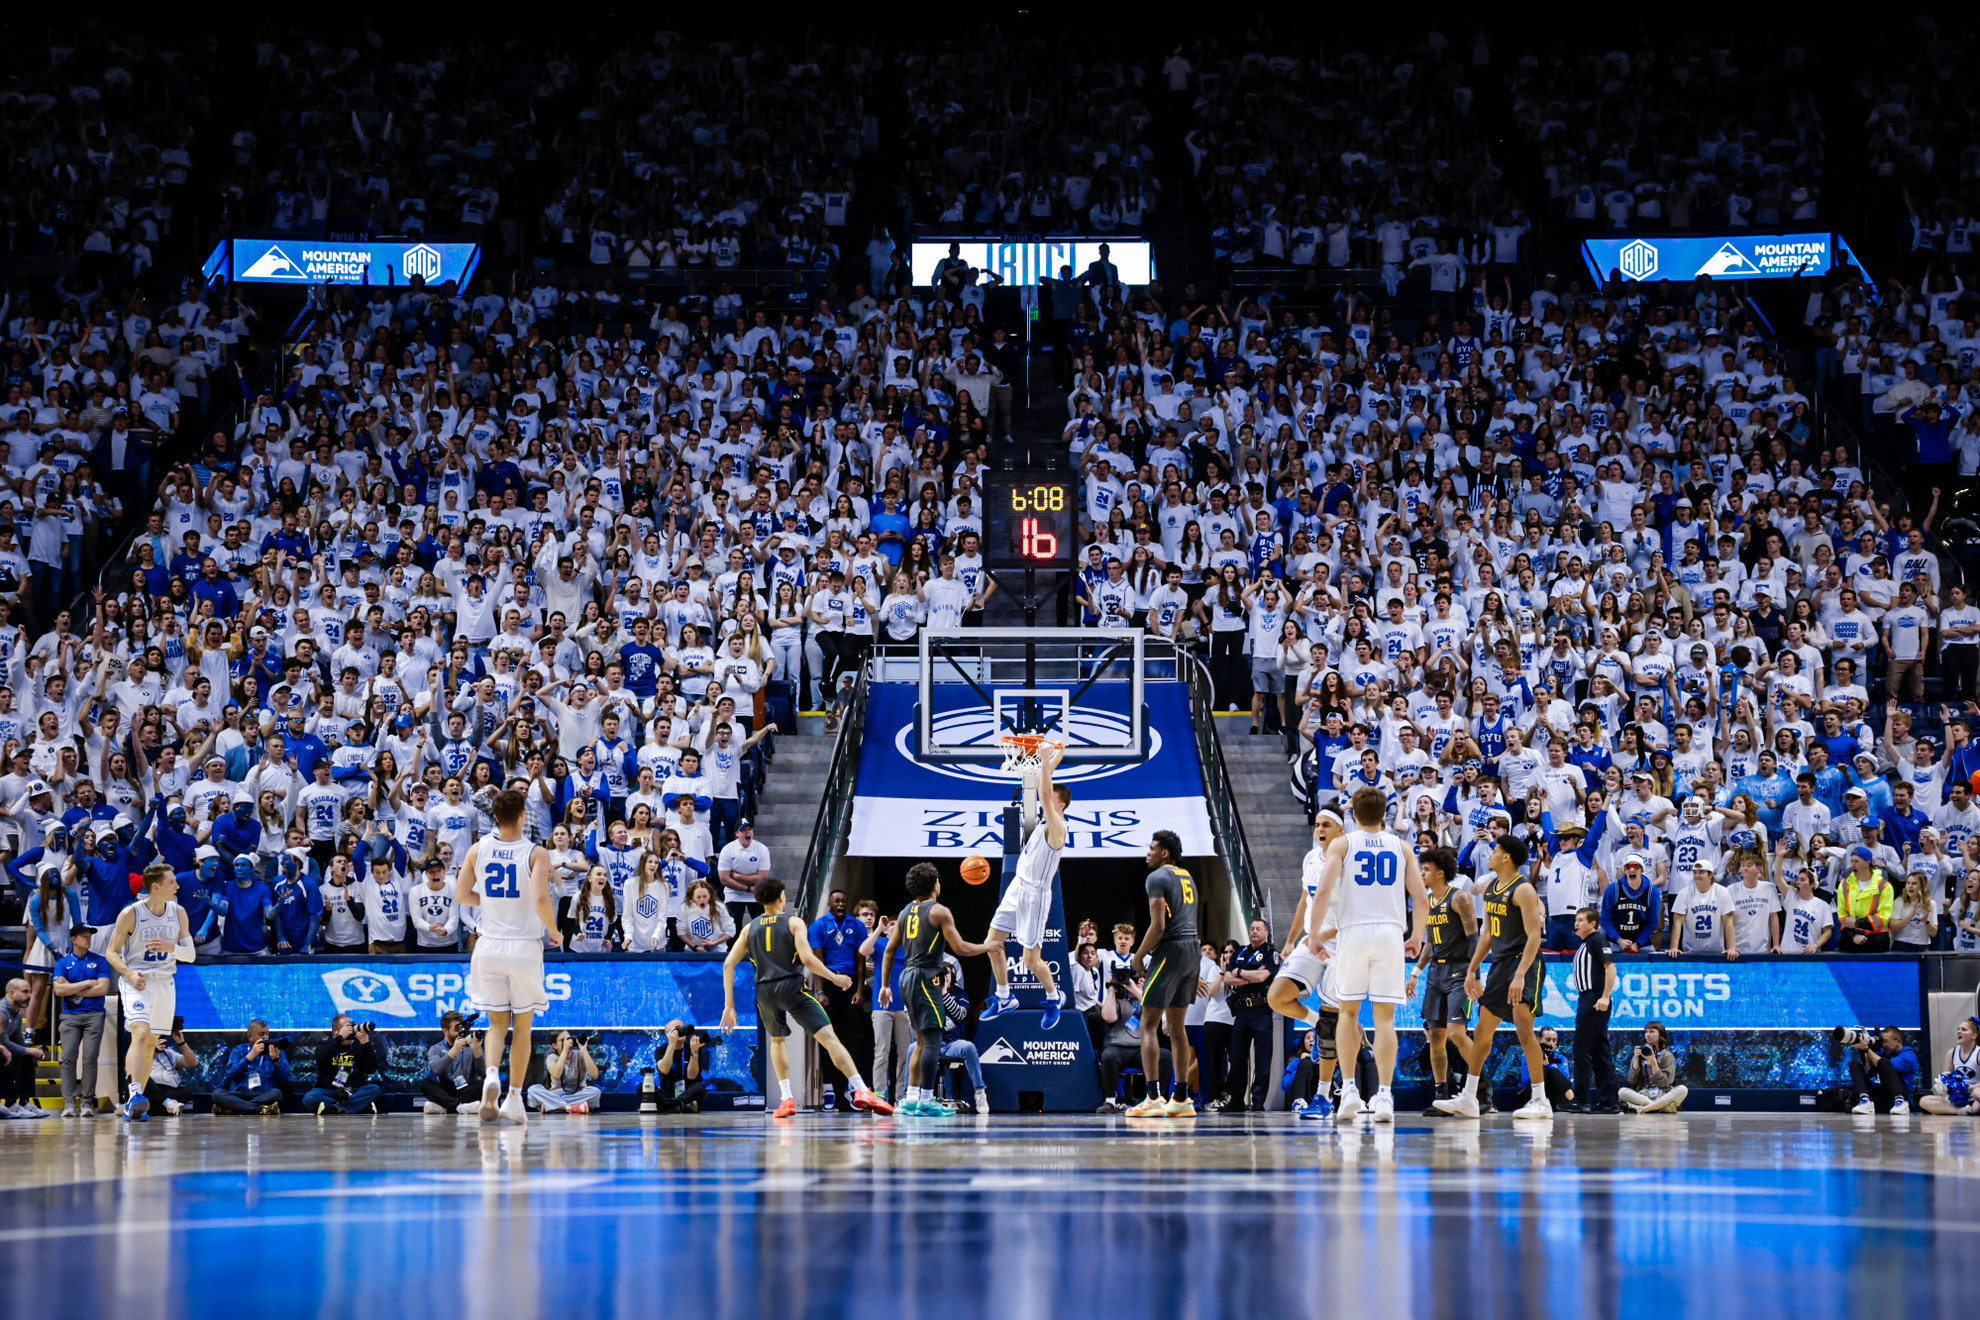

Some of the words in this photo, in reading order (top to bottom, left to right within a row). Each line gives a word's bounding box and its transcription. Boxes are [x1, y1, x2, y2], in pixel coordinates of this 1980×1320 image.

[1755, 242, 1825, 256] MOUNTAIN
[302, 250, 372, 262] MOUNTAIN
[1759, 254, 1820, 268] AMERICA
[306, 262, 365, 274] AMERICA
[1592, 414, 1605, 424] 24
[606, 484, 620, 495] 24
[1836, 480, 1848, 488] 32
[1012, 486, 1064, 511] 6:08
[1096, 492, 1110, 504] 24
[180, 514, 190, 522] 23
[1022, 518, 1056, 559] 16
[1261, 547, 1274, 558] 23
[1904, 559, 1928, 569] BALL
[964, 574, 977, 588] 24
[326, 624, 340, 638] 24
[1385, 630, 1408, 638] BRIGHAM
[1432, 627, 1456, 636] BRIGHAM
[1388, 640, 1402, 652] 24
[380, 686, 398, 694] CHOOSE
[384, 694, 396, 704] 32
[1501, 704, 1516, 719] 24
[1480, 734, 1502, 742] BYU
[1488, 744, 1493, 756] 1
[347, 754, 366, 762] CHOOSE
[450, 754, 468, 770] 32
[651, 756, 676, 766] BRIGHAM
[655, 764, 671, 778] 24
[608, 775, 622, 786] 32
[310, 797, 340, 806] BRIGHAM
[316, 805, 334, 820] 24
[924, 808, 1141, 828] ZINS
[408, 826, 425, 841] 24
[1946, 826, 1973, 834] BRIGHAM
[1366, 838, 1384, 848] HALL
[492, 850, 514, 860] KNELL
[1679, 846, 1698, 862] 23
[1354, 851, 1398, 886] 30
[485, 863, 520, 898] 21
[1555, 868, 1560, 882] 1
[1180, 878, 1195, 904] 15
[419, 896, 452, 907] BYU
[1690, 905, 1718, 914] BRIGHAM
[760, 916, 778, 925] LITTLE
[1427, 914, 1450, 926] AYLOR
[1627, 911, 1634, 924] 1
[1696, 914, 1712, 930] 24
[586, 916, 604, 932] 24
[907, 914, 920, 940] 13
[1491, 916, 1500, 938] 10
[1794, 918, 1810, 938] 24
[140, 926, 176, 942] BYU
[766, 926, 772, 952] 1
[1433, 926, 1442, 944] 11
[408, 974, 571, 1001] SPS
[1611, 999, 1704, 1018] ATION
[1024, 1041, 1080, 1051] MOUNTAIN
[1026, 1051, 1076, 1060] AMERICA
